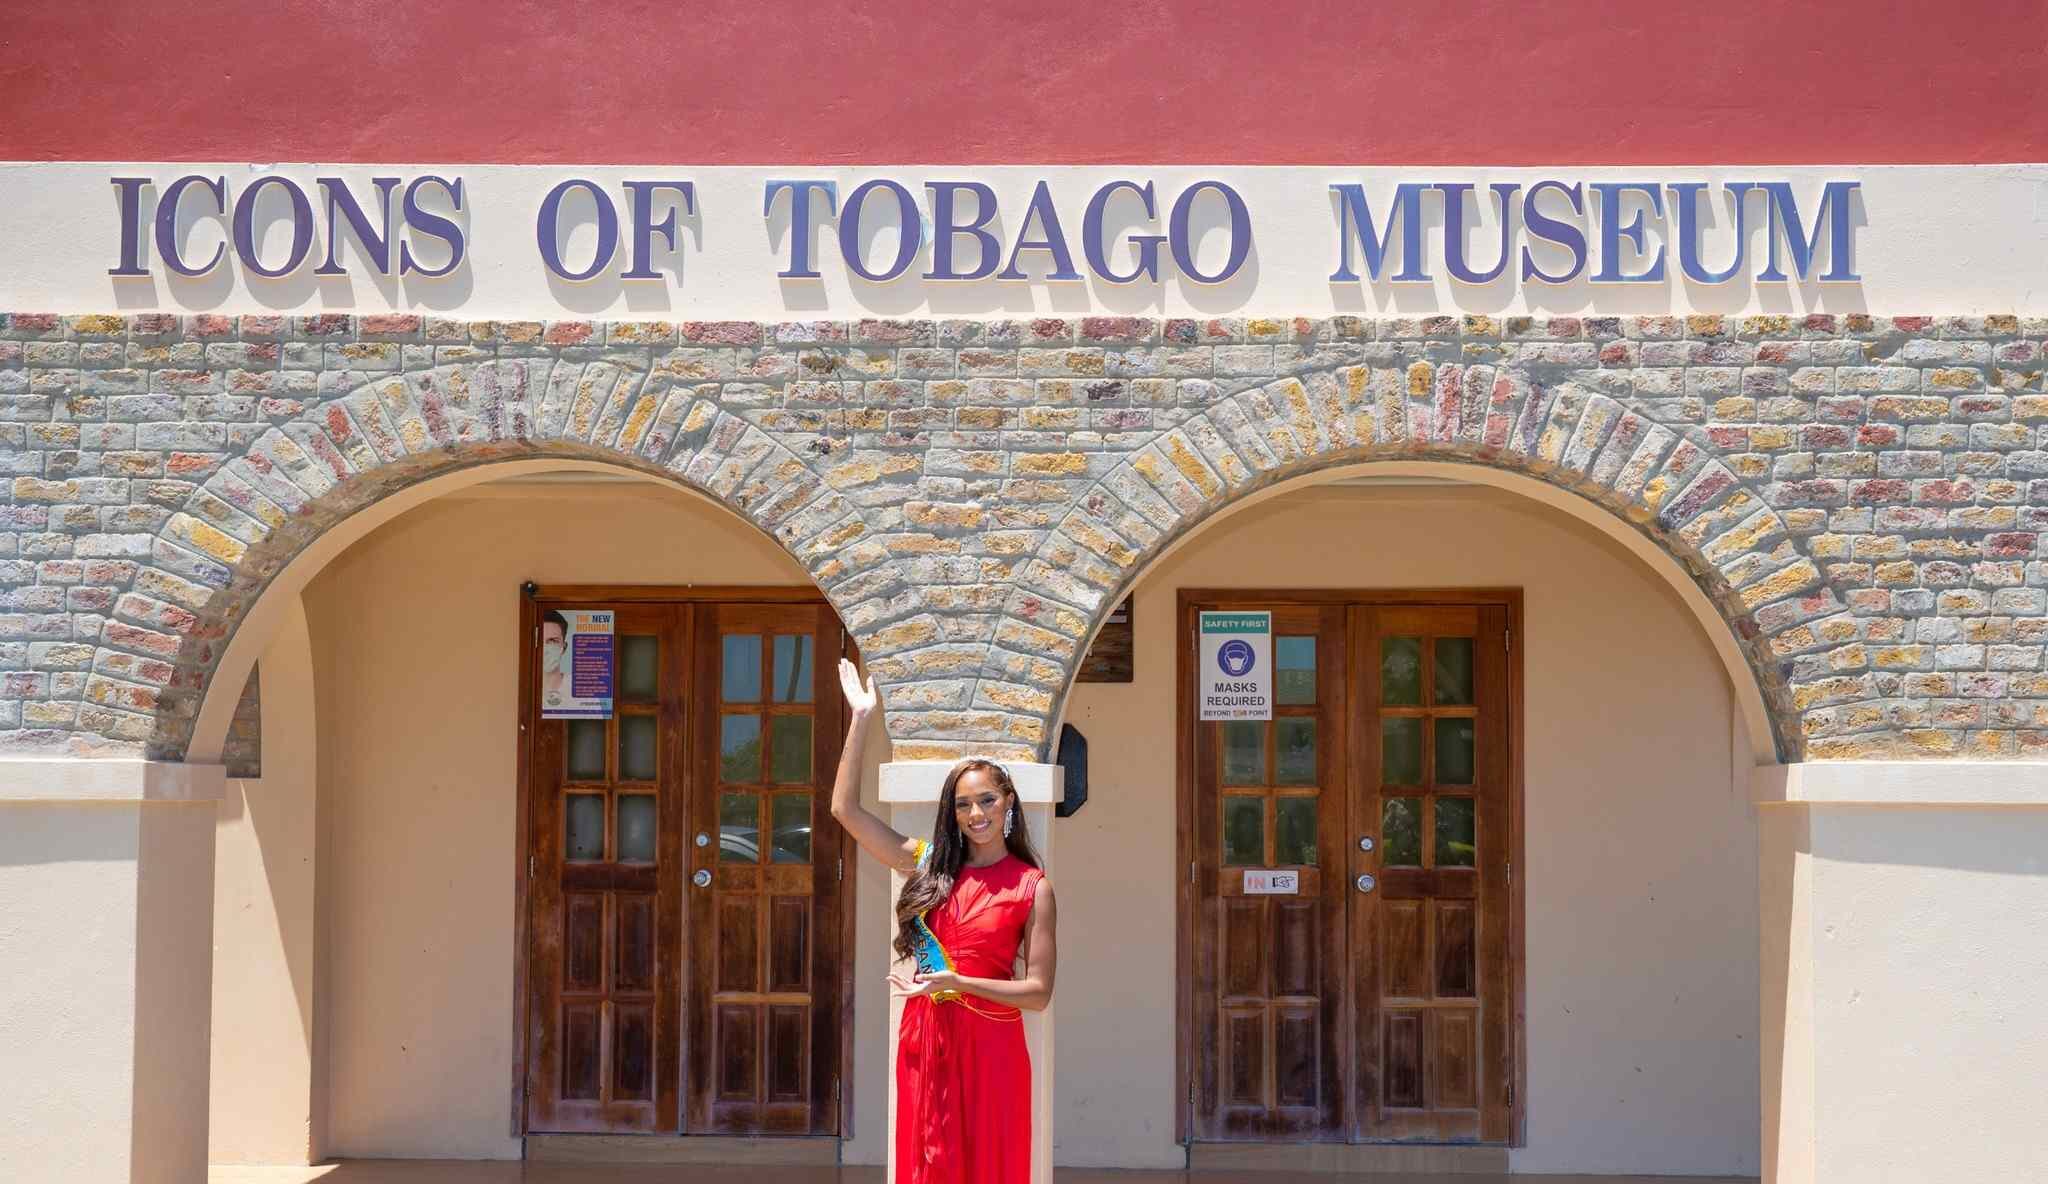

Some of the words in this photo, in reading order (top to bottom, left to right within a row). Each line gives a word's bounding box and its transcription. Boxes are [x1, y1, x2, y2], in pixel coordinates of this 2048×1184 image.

[108, 175, 466, 278] ICONS
[536, 179, 695, 281] OF
[764, 179, 1252, 284] TOBAGO
[1329, 180, 1862, 285] MUSEUM
[592, 614, 611, 623] NEW
[1204, 620, 1239, 628] SAFETY
[1241, 620, 1266, 628] FIRST
[1215, 682, 1257, 693] MASKS
[1207, 696, 1265, 706] REQUIRED
